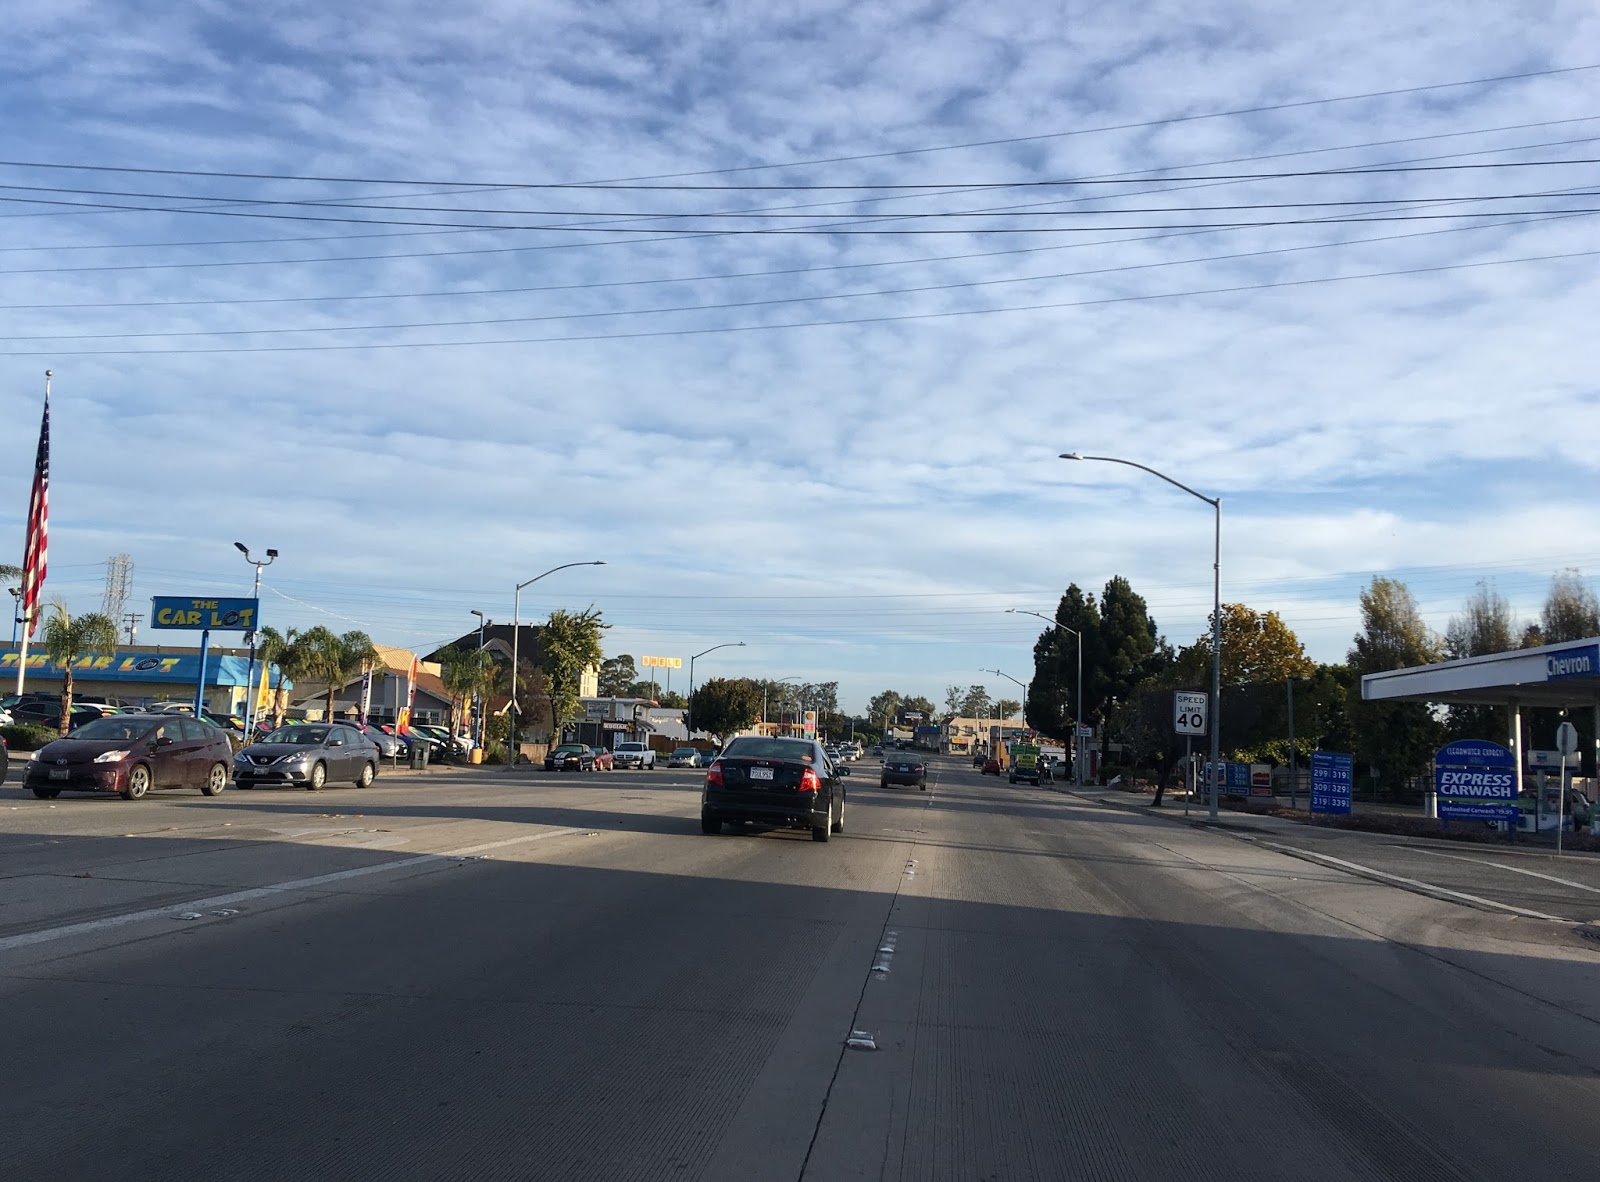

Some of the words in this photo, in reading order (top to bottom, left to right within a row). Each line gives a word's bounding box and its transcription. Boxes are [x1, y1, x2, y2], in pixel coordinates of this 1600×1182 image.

[191, 600, 218, 609] THE
[157, 608, 202, 625] CAR
[210, 609, 254, 627] LOT
[1, 653, 49, 668] THE
[57, 656, 114, 670] CAR
[118, 657, 180, 672] LOT
[1547, 655, 1590, 676] Chevron
[1177, 696, 1205, 704] SPEED
[1179, 705, 1202, 713] LIMIT
[1177, 713, 1203, 728] 40
[1313, 769, 1329, 777] 299
[1332, 771, 1347, 779] 319
[1441, 772, 1512, 786] EXPRESS
[1313, 783, 1328, 792] 309
[1331, 785, 1347, 793] 329
[1440, 784, 1511, 797] CARWASH
[1313, 797, 1328, 806] 319
[1331, 799, 1346, 807] 339
